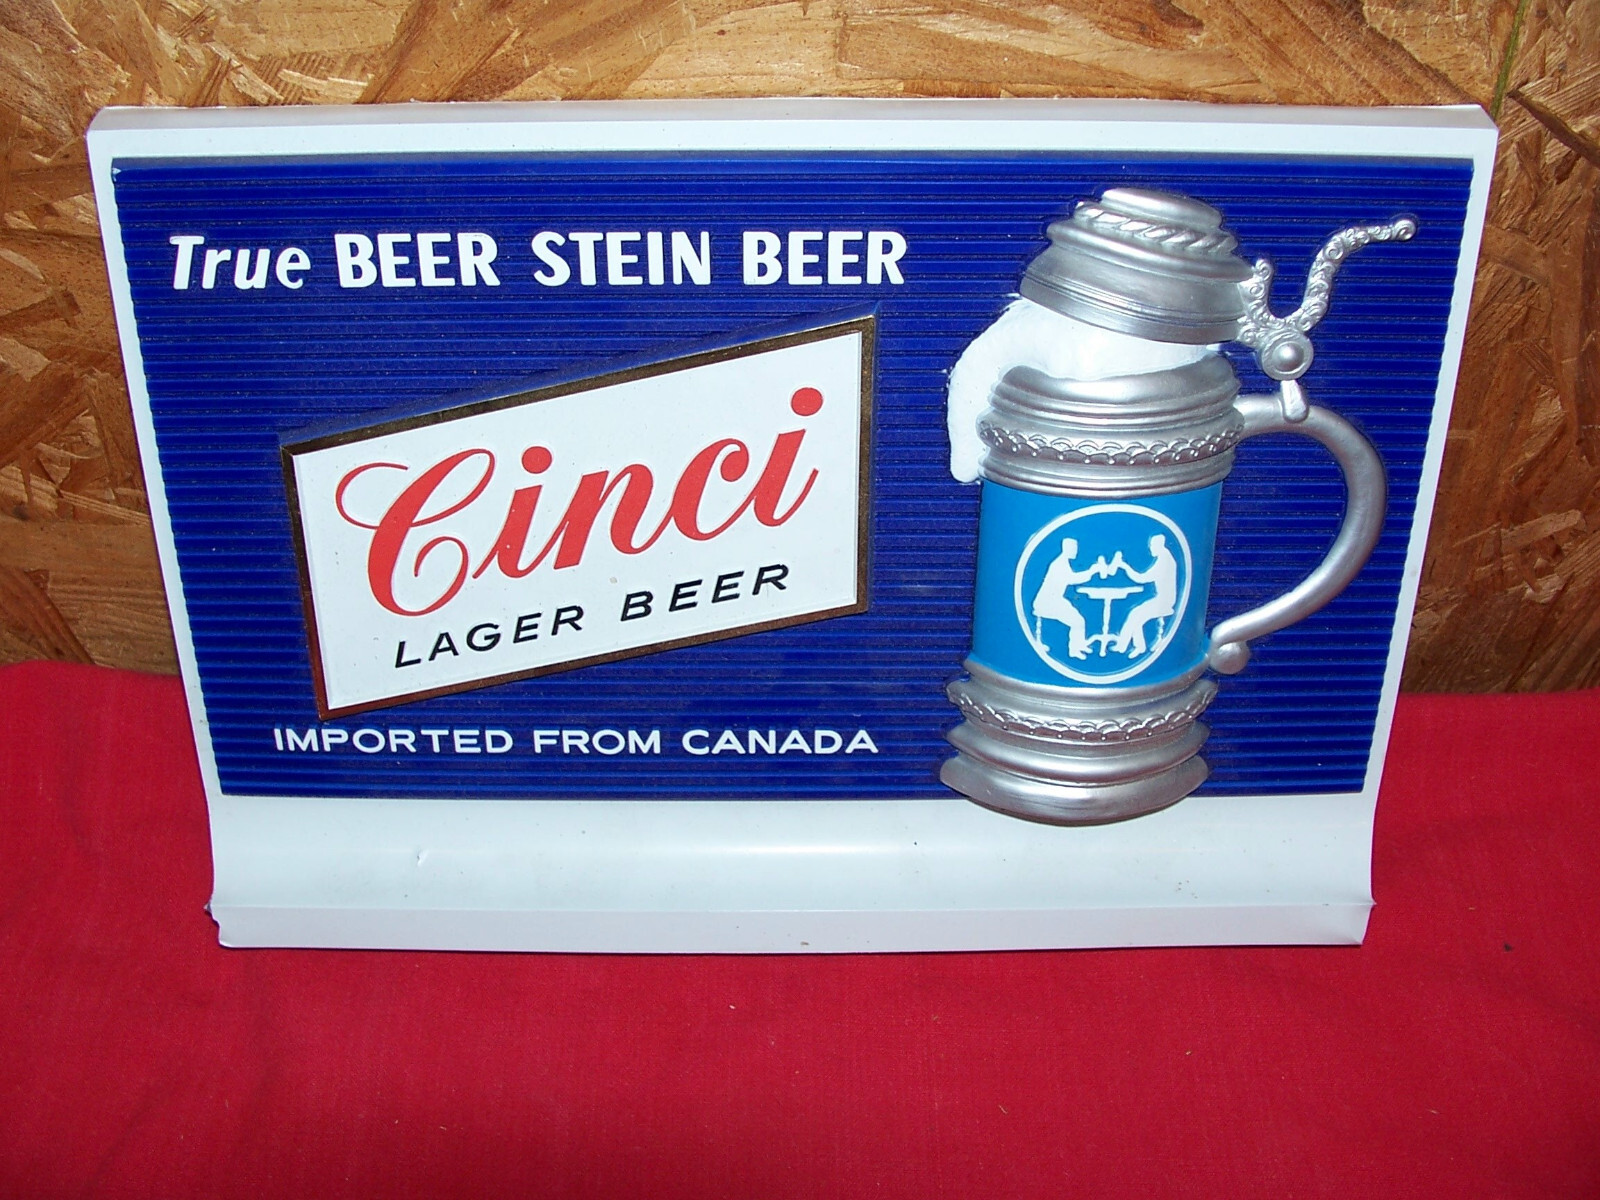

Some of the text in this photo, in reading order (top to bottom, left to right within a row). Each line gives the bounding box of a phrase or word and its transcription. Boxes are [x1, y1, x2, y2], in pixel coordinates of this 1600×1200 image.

[169, 230, 908, 290] True BEER STEIN BEER
[335, 387, 824, 617] Cinci
[394, 563, 789, 669] LAGER BEER
[273, 728, 879, 755] IMPORTED FROM CANADA
